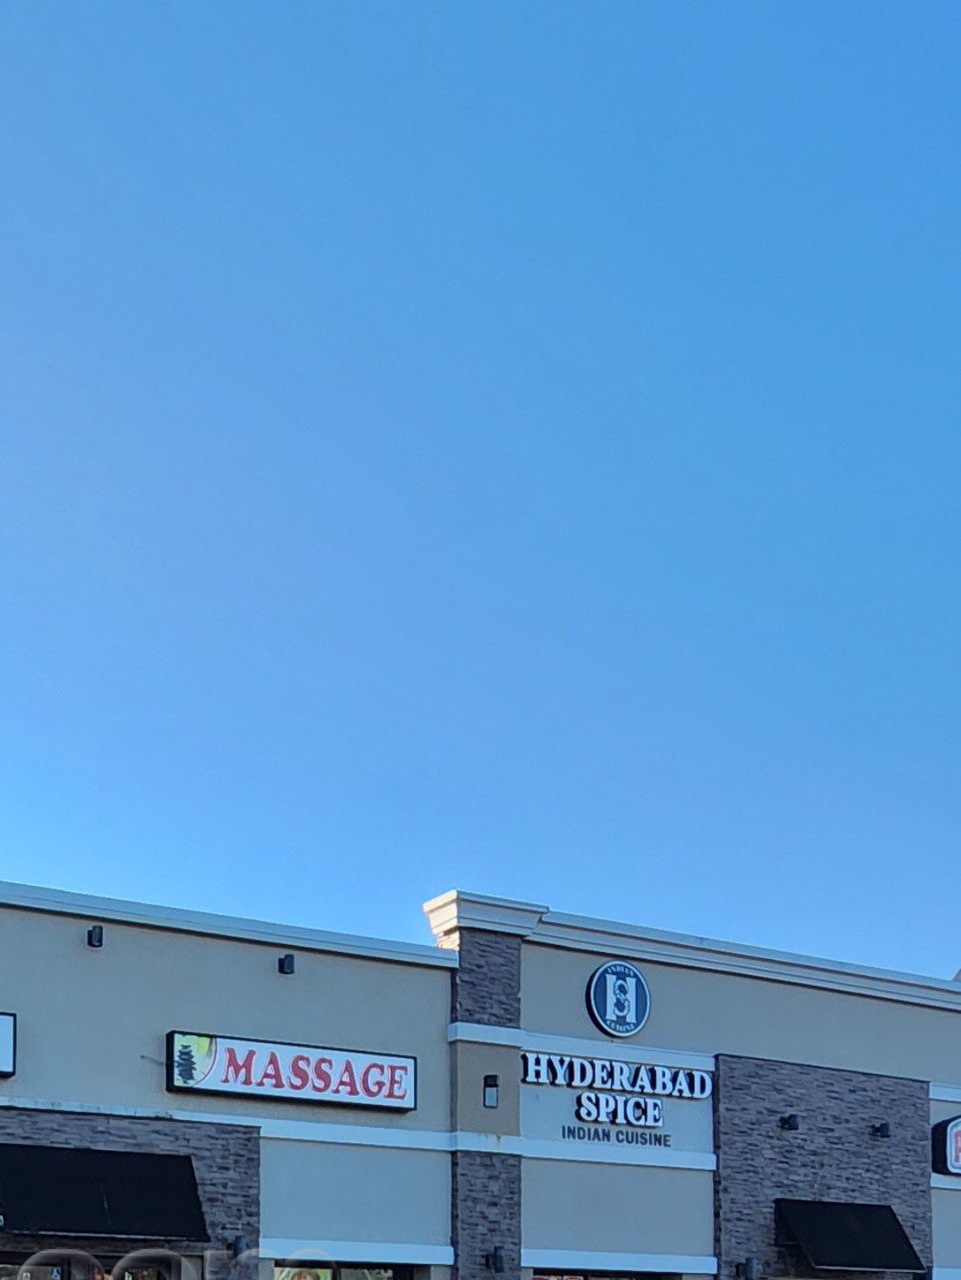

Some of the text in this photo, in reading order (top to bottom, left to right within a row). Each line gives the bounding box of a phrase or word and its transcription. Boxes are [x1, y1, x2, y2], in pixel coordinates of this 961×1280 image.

[221, 1047, 409, 1101] MASSAGE
[523, 1052, 713, 1100] HYDERABAD
[578, 1091, 664, 1128] SPICE
[561, 1125, 672, 1148] INDIAN CUISINE
